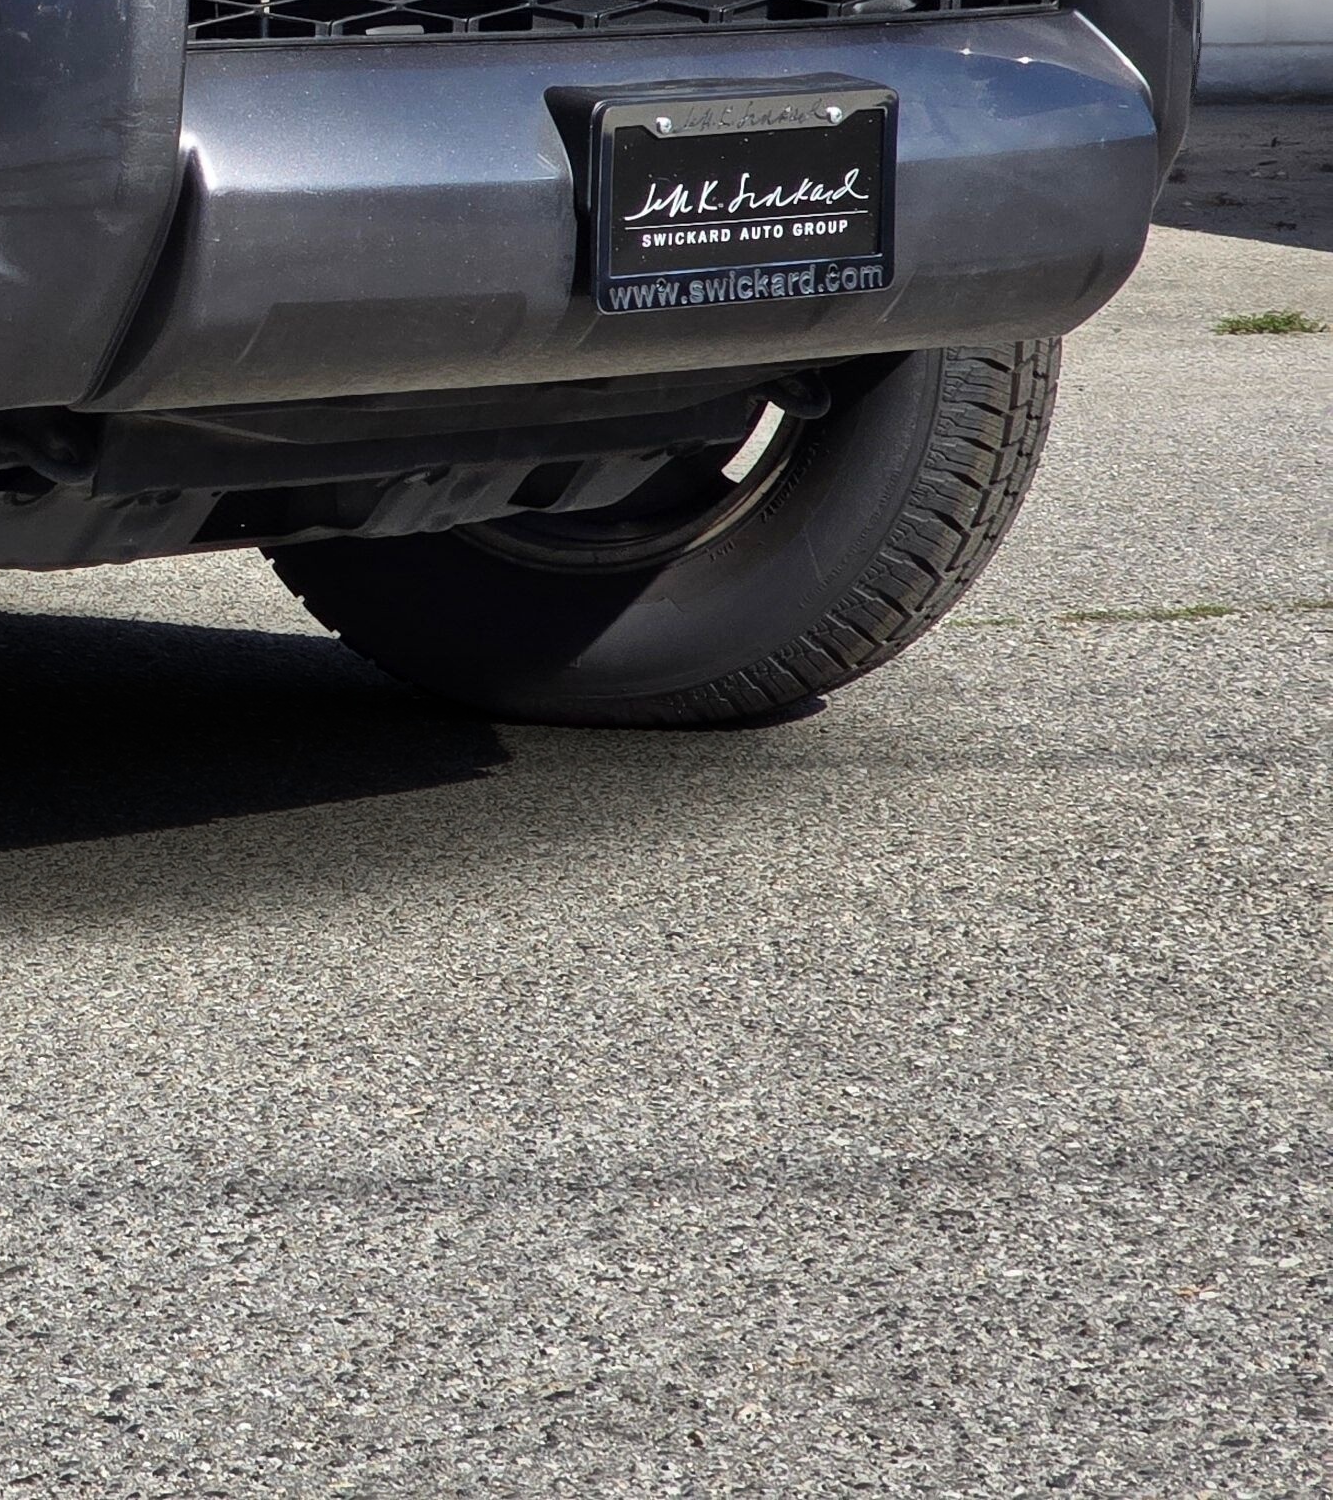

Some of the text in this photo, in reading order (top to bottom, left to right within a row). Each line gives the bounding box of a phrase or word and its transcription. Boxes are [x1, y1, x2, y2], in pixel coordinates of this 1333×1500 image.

[641, 219, 849, 248] SWICKARD AUTO GROUP
[609, 264, 883, 310] www.swickard.com
